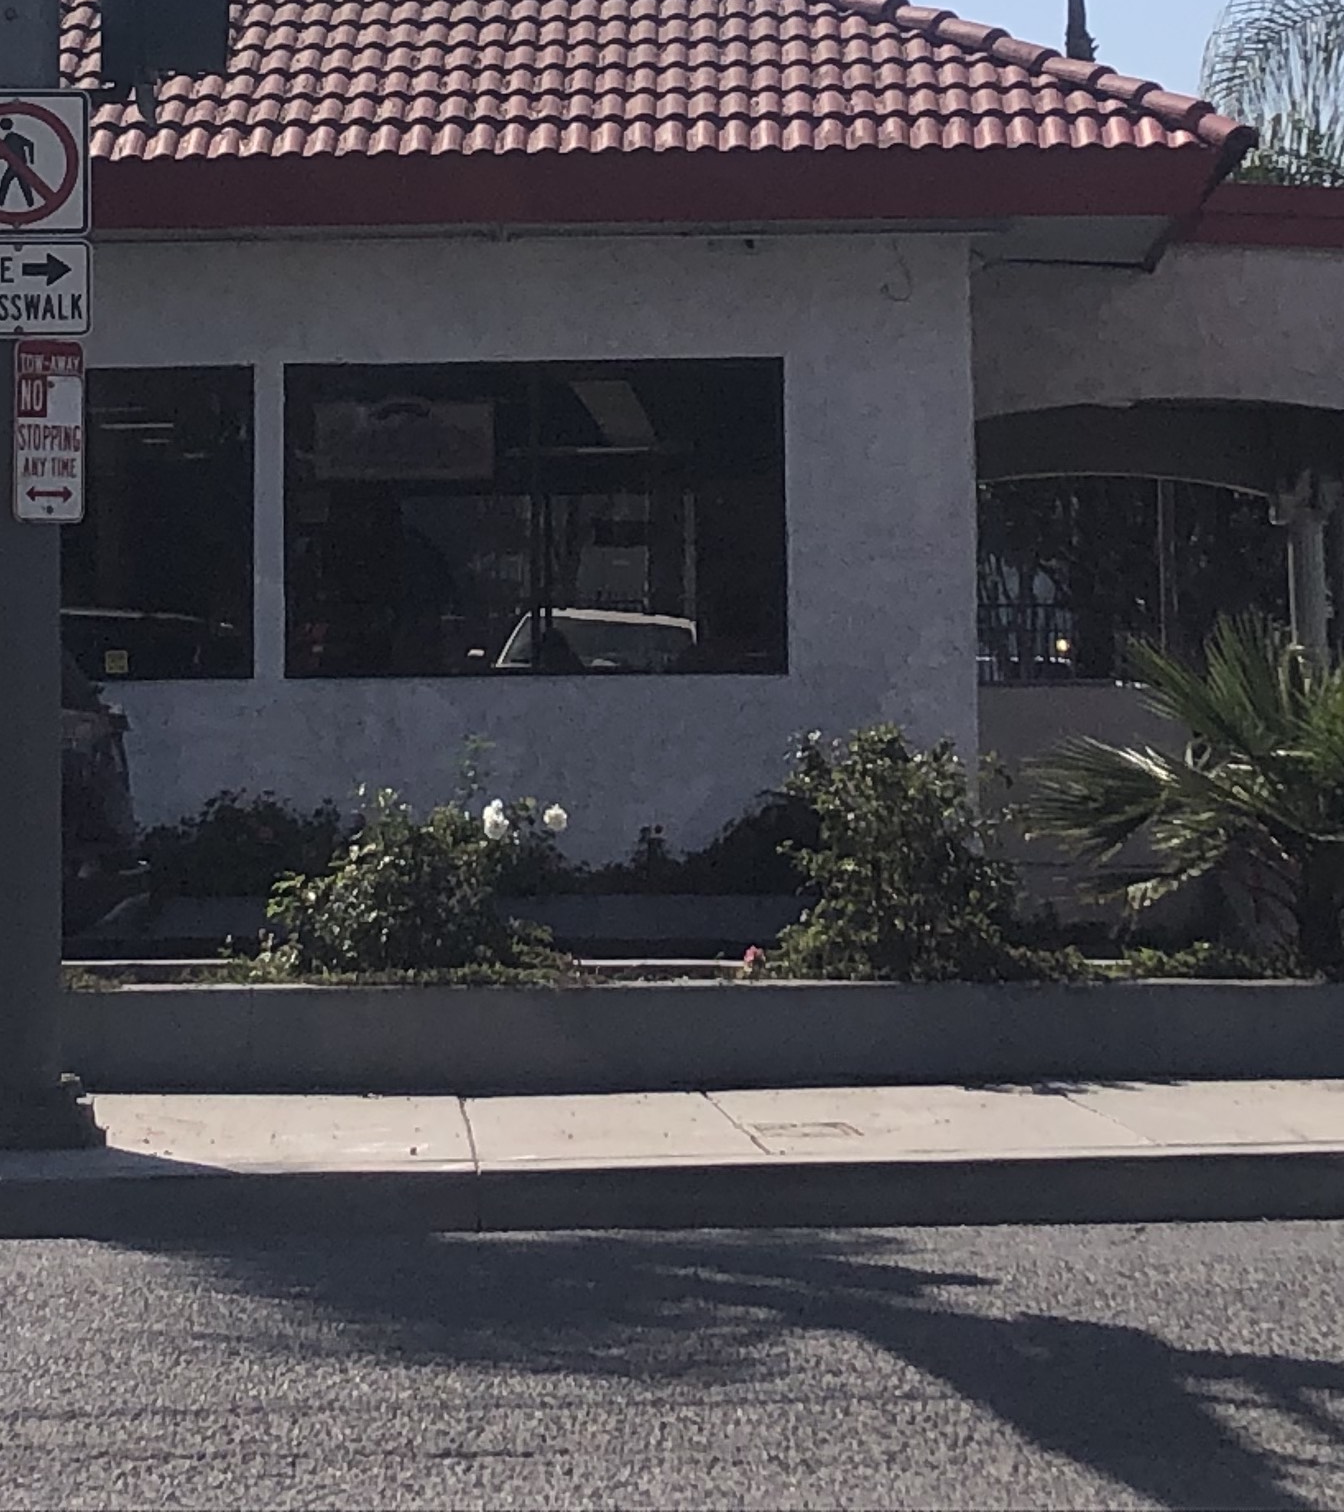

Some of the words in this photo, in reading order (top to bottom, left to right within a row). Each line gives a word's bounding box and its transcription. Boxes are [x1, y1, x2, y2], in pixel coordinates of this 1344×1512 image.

[20, 352, 81, 375] TOW-AWAY
[21, 379, 43, 412] NO
[17, 424, 81, 453] STOPPING
[23, 456, 48, 479] ANY
[51, 456, 78, 479] TIME
